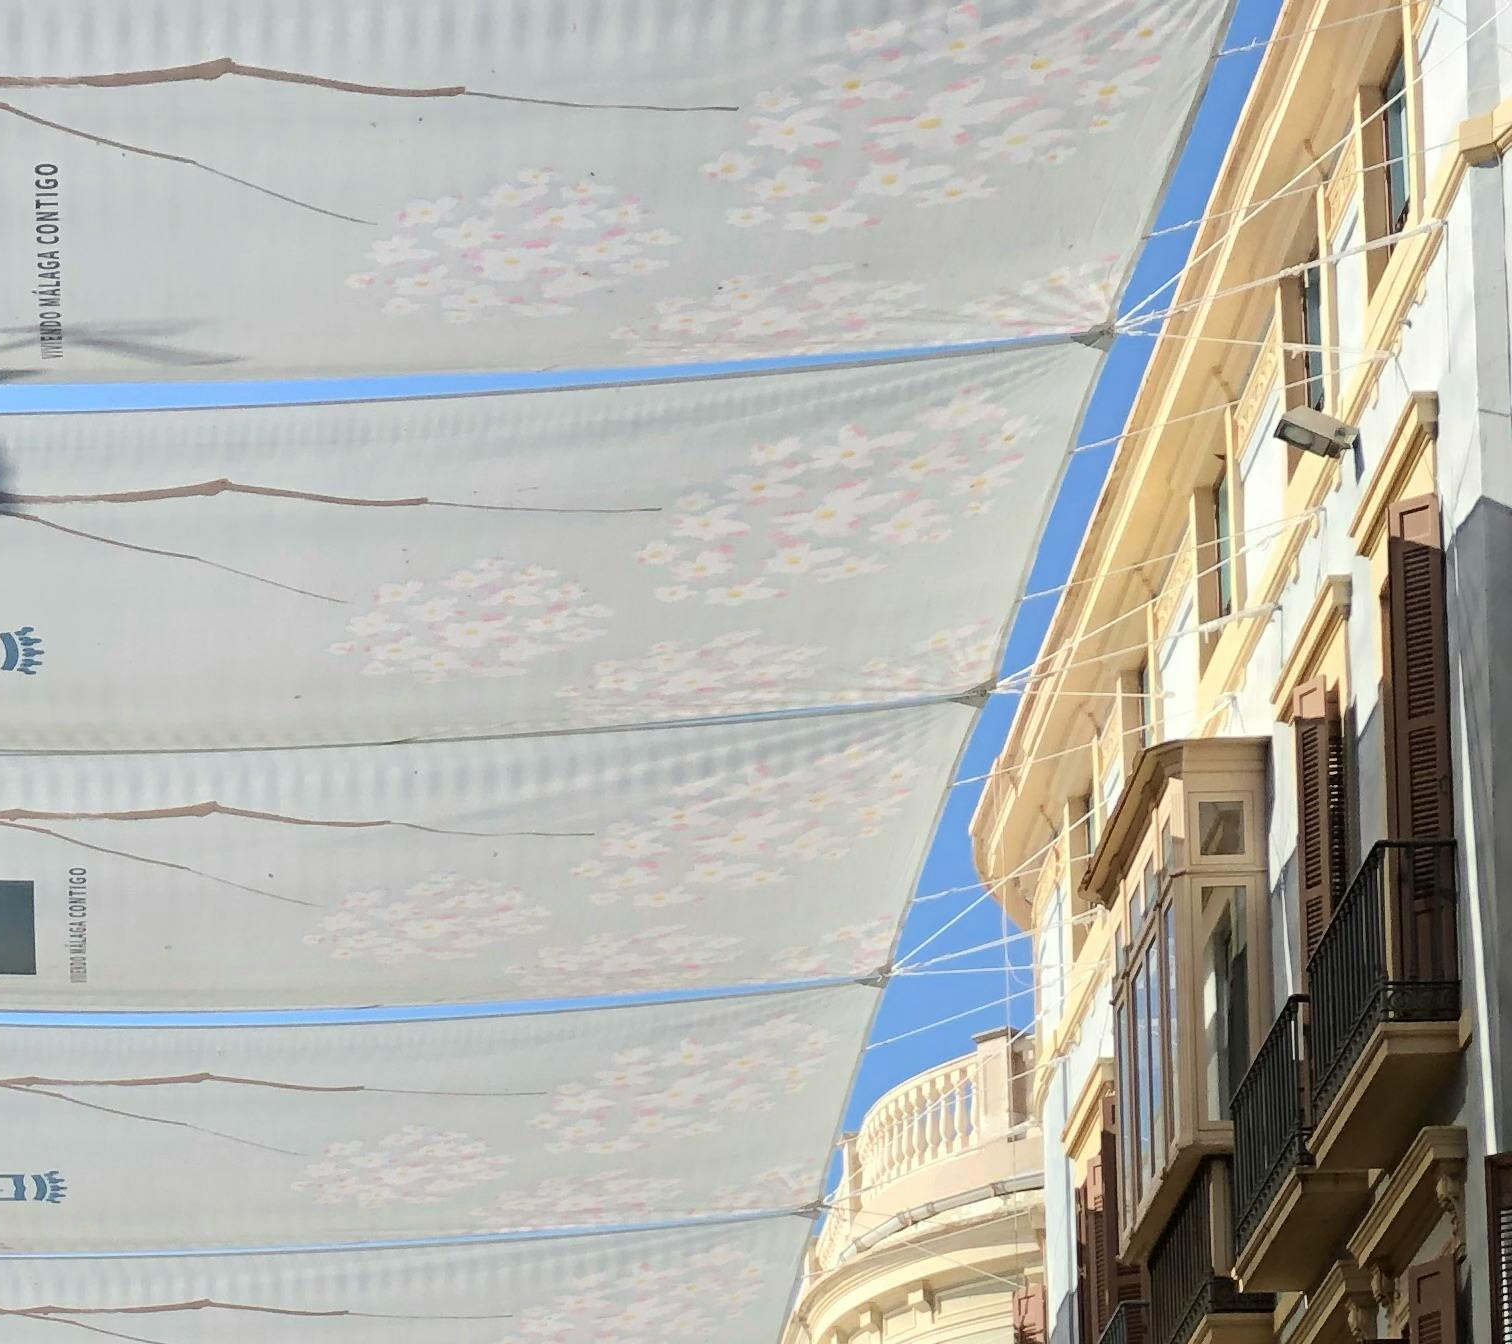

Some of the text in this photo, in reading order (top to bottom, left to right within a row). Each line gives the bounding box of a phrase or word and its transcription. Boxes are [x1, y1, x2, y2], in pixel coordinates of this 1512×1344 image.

[32, 163, 63, 360] VIVIENDO MÁLAGA CONTIGO
[68, 867, 88, 918] CONTIGO
